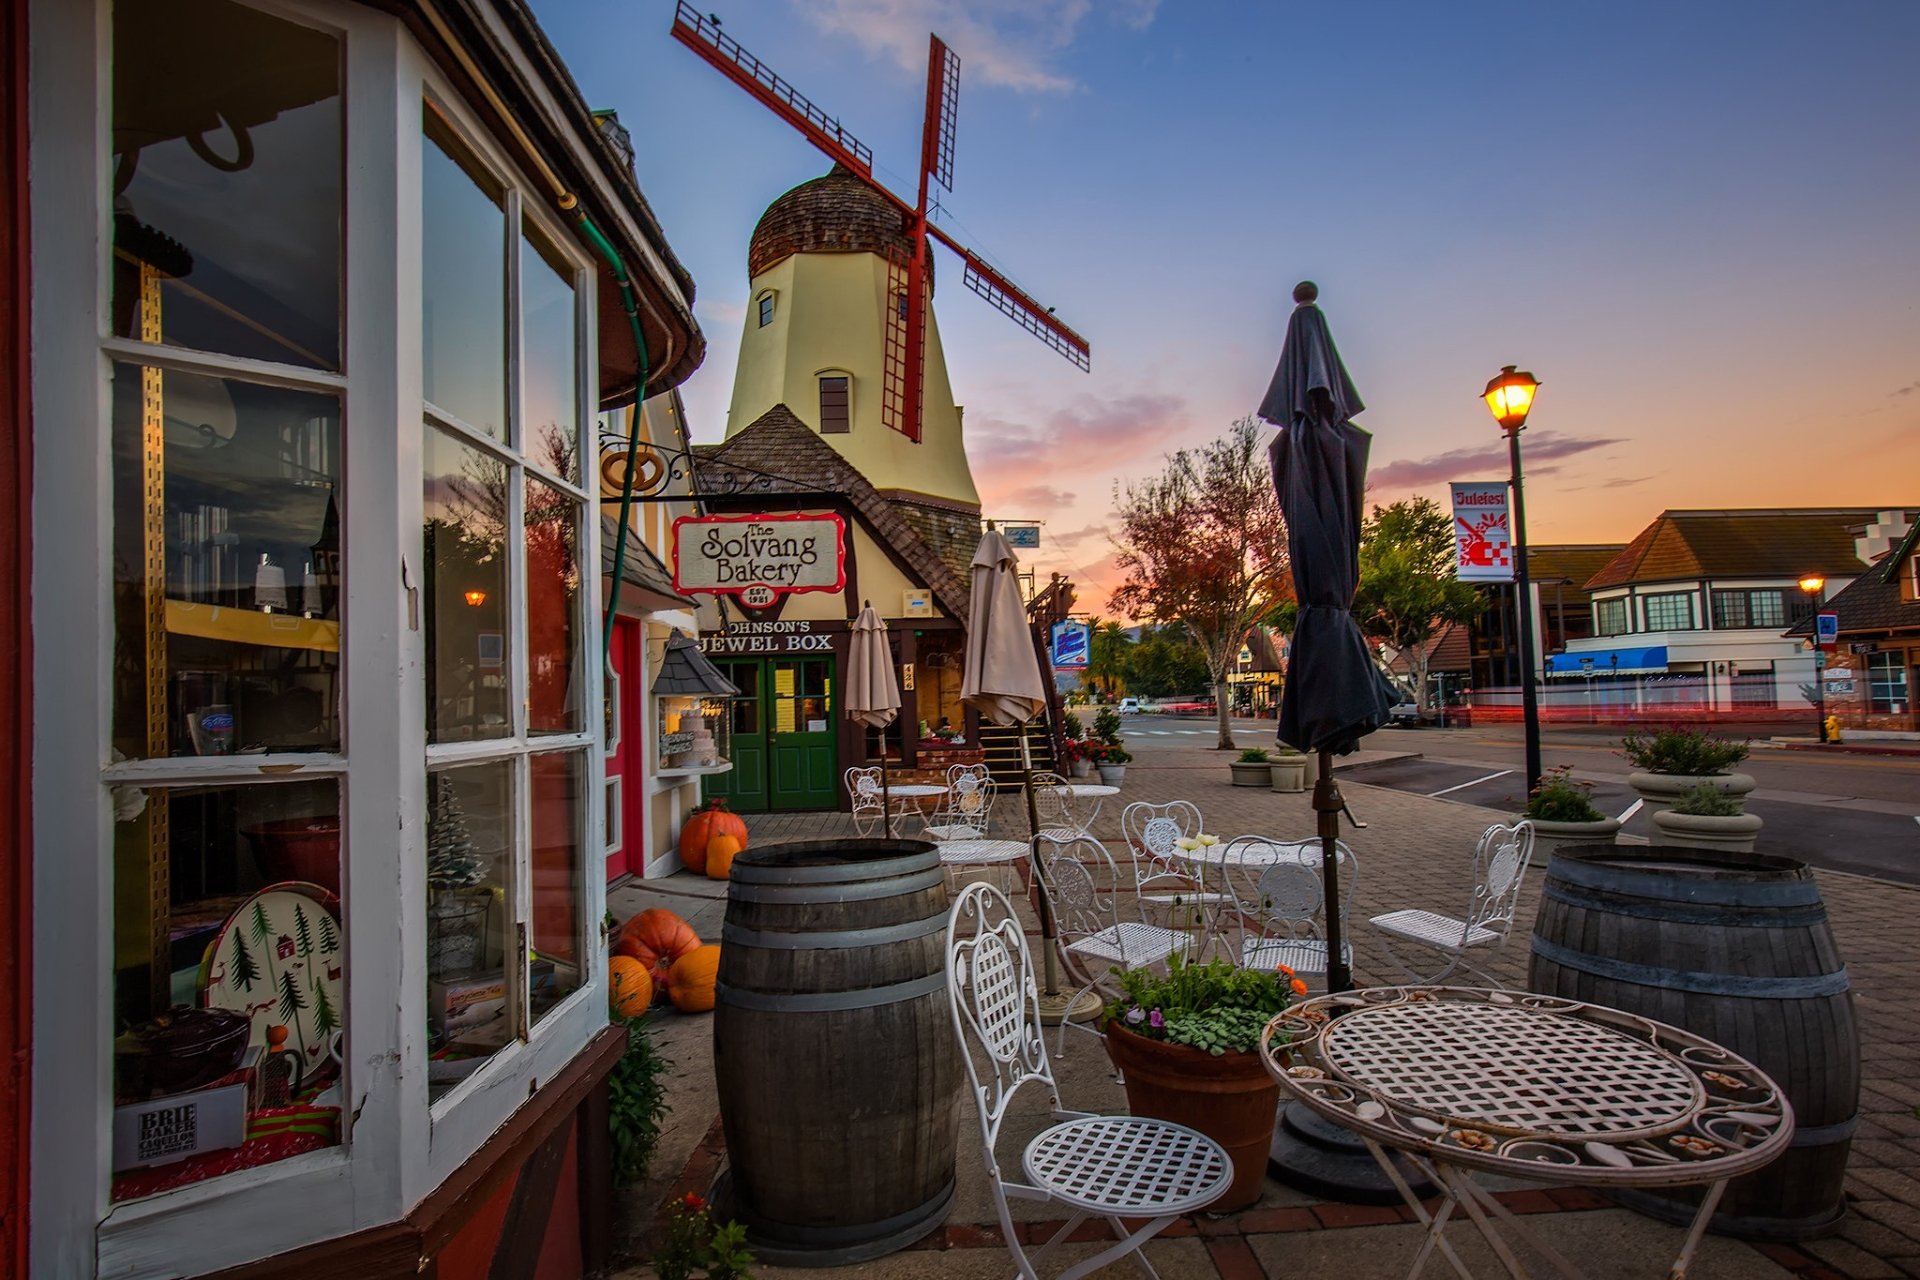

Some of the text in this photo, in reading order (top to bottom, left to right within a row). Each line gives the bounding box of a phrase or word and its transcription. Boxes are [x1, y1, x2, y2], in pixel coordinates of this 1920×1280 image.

[1456, 492, 1505, 505] Julefest
[748, 524, 774, 536] The
[701, 528, 817, 565] Solvang
[717, 558, 803, 586] Bakery
[730, 621, 810, 634] OHNSON'S
[699, 634, 833, 652] JEWEL BOX
[141, 1103, 196, 1129] BRIE
[141, 1120, 196, 1140] BAKER
